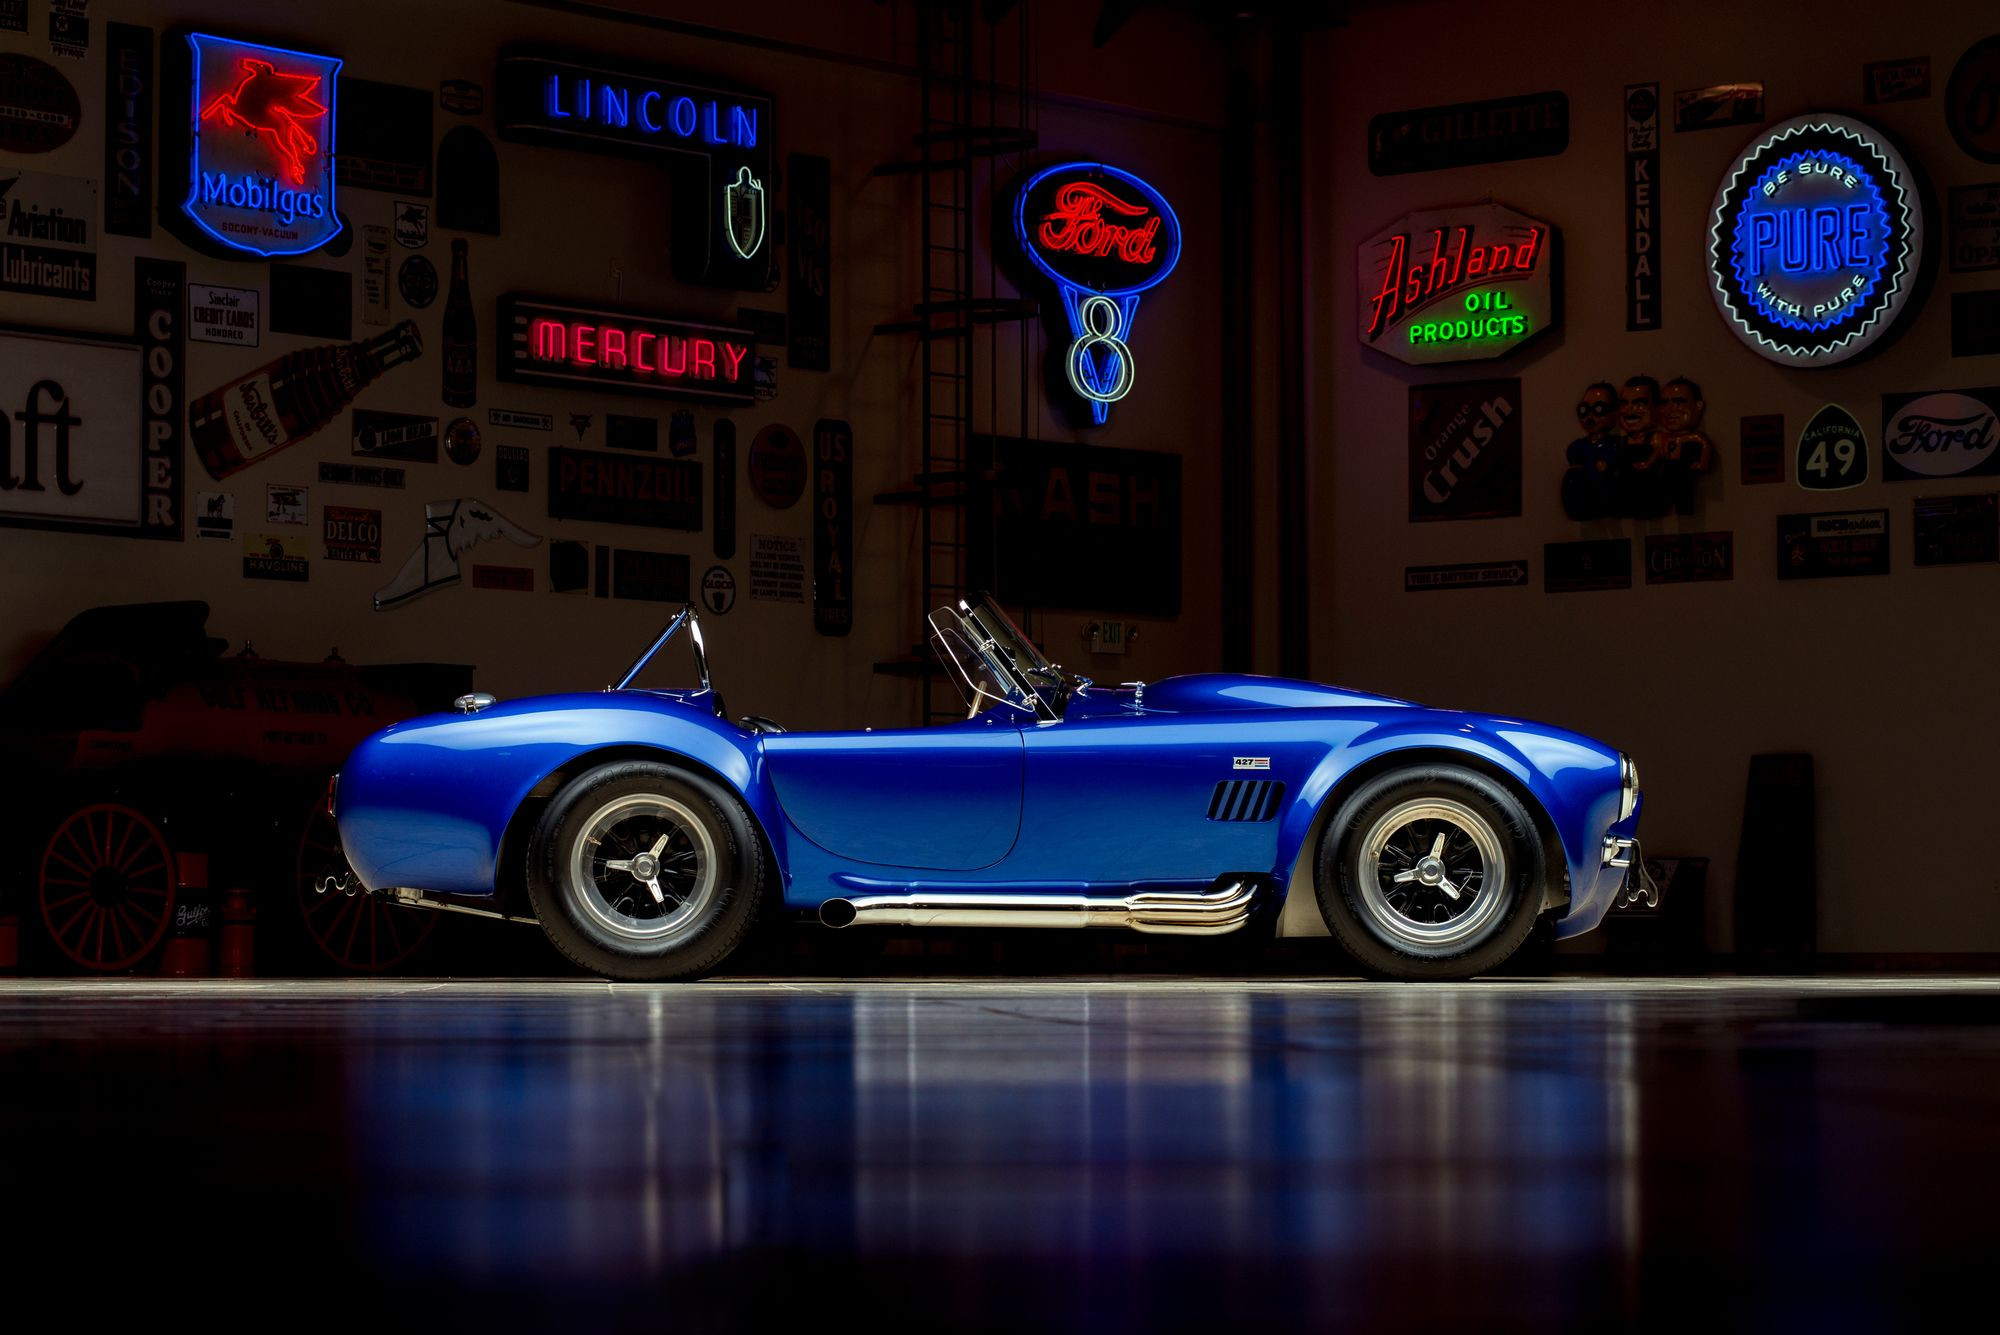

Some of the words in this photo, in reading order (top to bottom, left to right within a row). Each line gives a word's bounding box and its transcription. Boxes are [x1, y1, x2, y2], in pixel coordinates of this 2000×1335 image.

[116, 49, 143, 198] EDISON
[546, 74, 757, 148] LINCOLN
[1420, 101, 1562, 145] GILLETTE
[202, 171, 323, 225] Mobilgas
[1763, 170, 1790, 196] BE
[1799, 162, 1858, 189] SURE
[8, 200, 86, 244] Aviation
[1038, 181, 1161, 264] Ford
[1634, 160, 1651, 325] KENDALL
[1751, 204, 1871, 276] PURE
[2, 247, 91, 293] Lubricants
[1367, 226, 1540, 335] Ashland
[193, 306, 224, 325] CREDIT
[227, 310, 255, 328] CARDS
[209, 291, 241, 307] Sinclair
[1464, 291, 1510, 313] OIL
[1757, 282, 1801, 317] WITH
[1813, 274, 1866, 318] PURE
[205, 328, 244, 341] HONORED
[530, 319, 747, 383] MERCURY
[1409, 315, 1526, 345] PRODUCTS
[147, 307, 177, 527] COOPER
[1424, 402, 1473, 461] Orange
[1804, 425, 1861, 442] CALIFORNIA
[1889, 412, 1995, 455] Ford
[498, 447, 529, 462] DOUGLAS
[819, 432, 847, 463] US
[1422, 395, 1514, 505] Crush
[1805, 438, 1856, 479] 49
[560, 454, 697, 505] PENNZOIL
[325, 519, 378, 545] DELCO
[759, 539, 797, 552] NOTICE
[819, 468, 848, 603] ROYAL
[248, 559, 305, 573] HAVOLINE
[1441, 571, 1479, 582] BATTERY
[1482, 568, 1518, 579] SERVICE
[1103, 622, 1122, 644] EXIT
